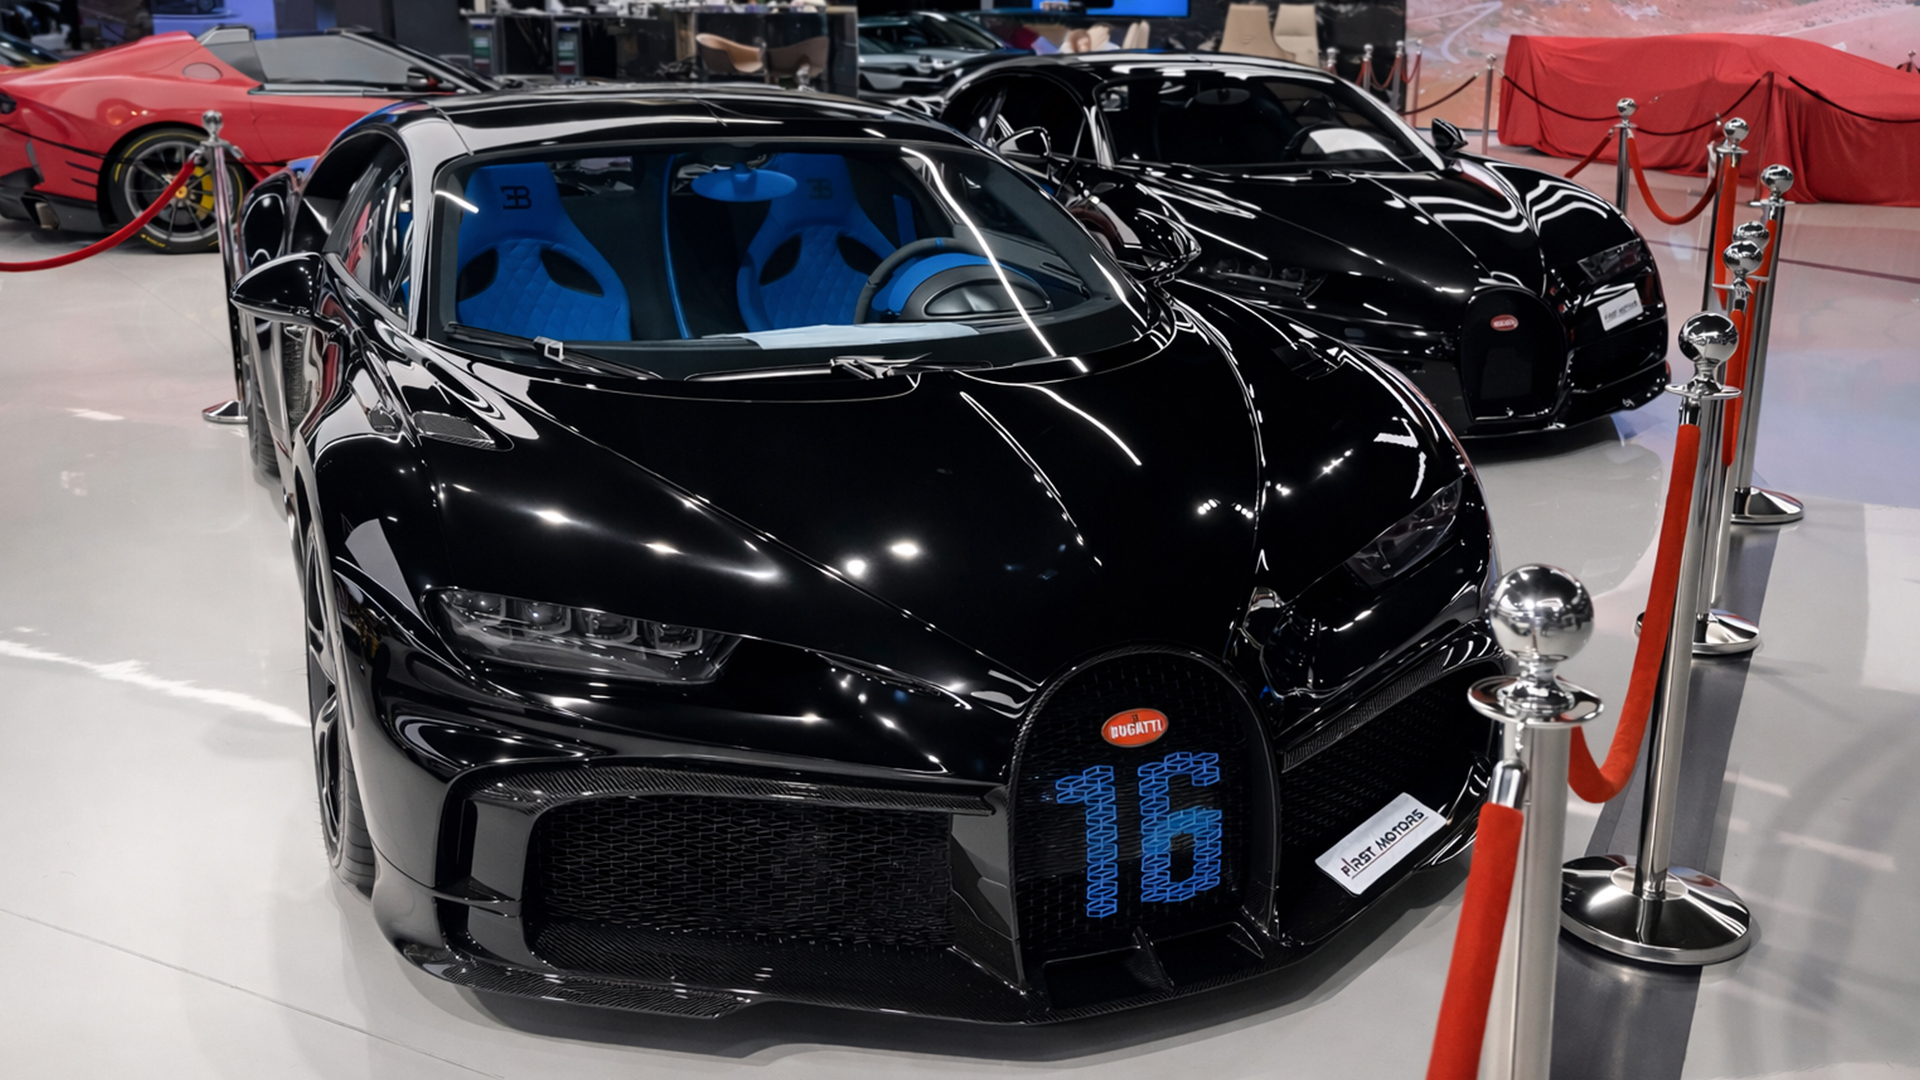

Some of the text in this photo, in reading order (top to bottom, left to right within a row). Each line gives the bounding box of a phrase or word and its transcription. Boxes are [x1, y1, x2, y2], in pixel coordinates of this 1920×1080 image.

[1110, 719, 1163, 739] BUGATTI
[1055, 751, 1222, 919] 16
[1340, 808, 1425, 878] FIRST MOTORS
